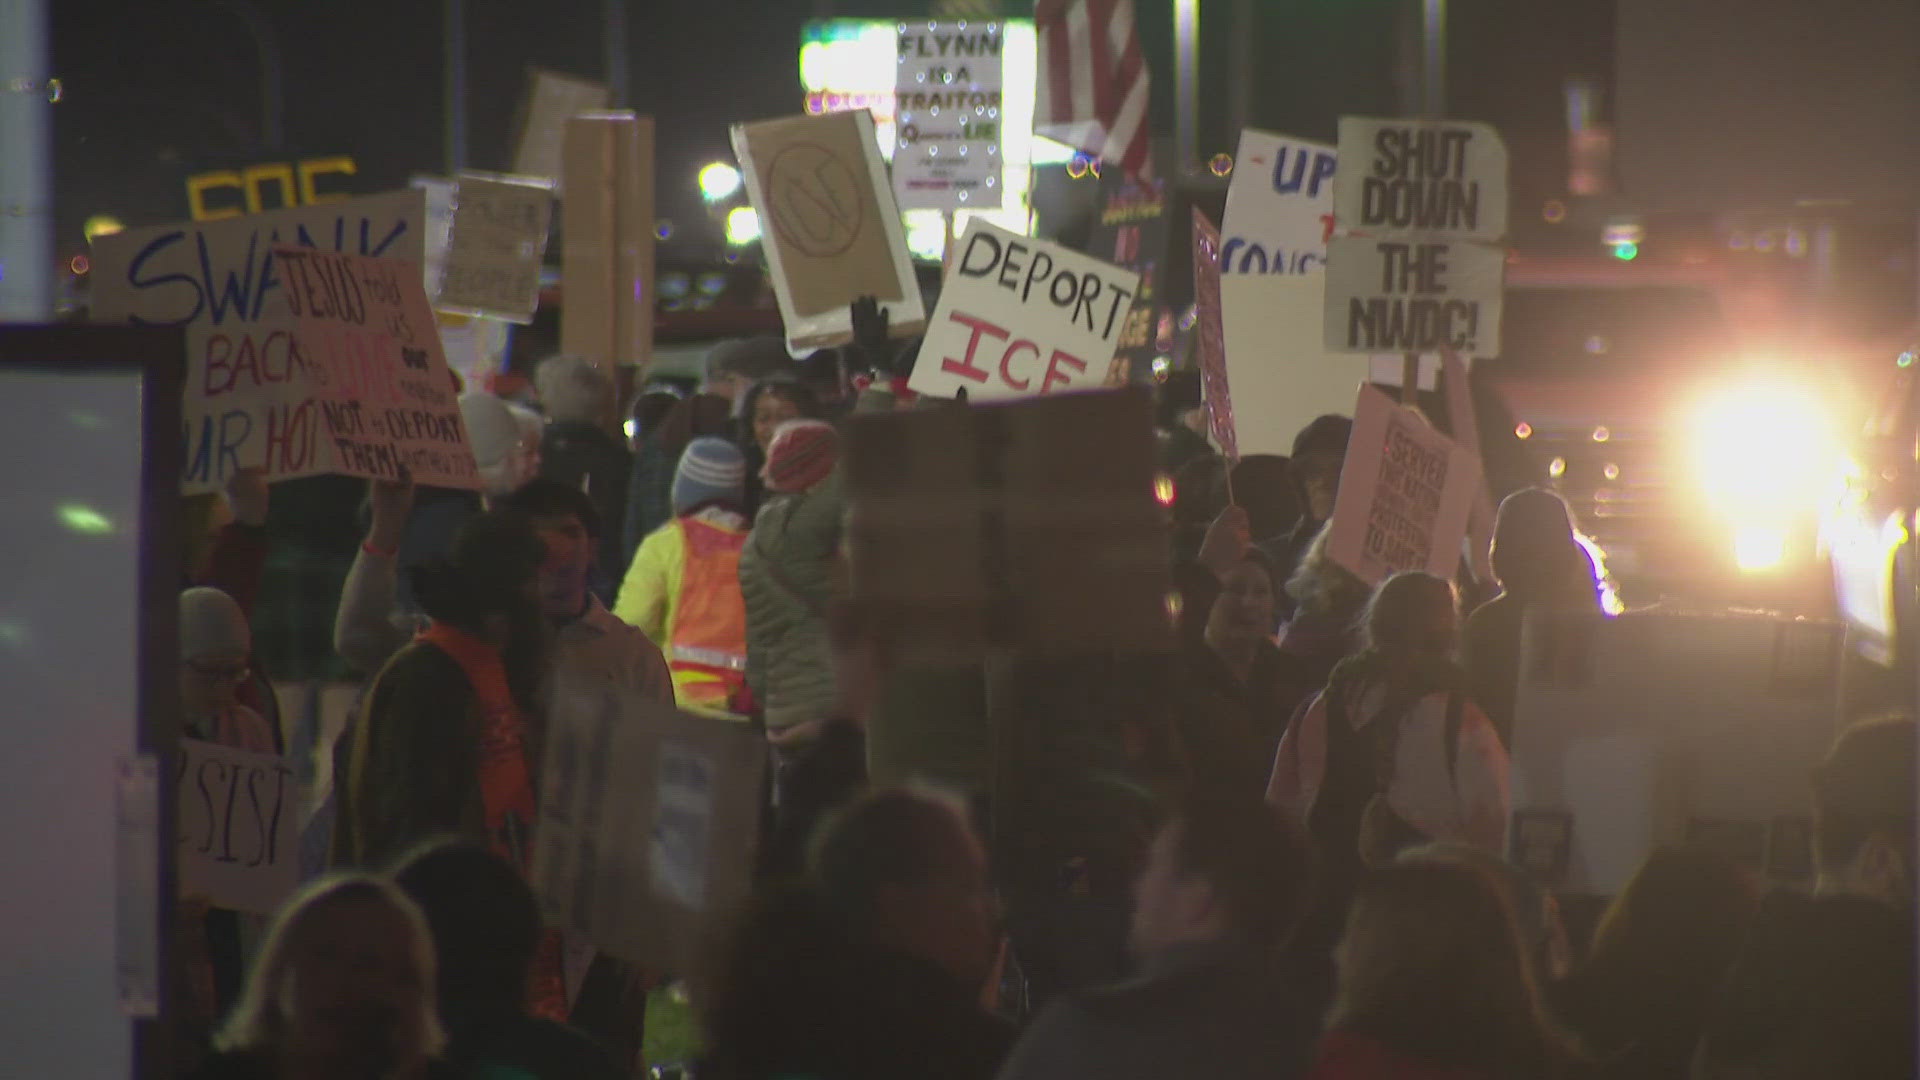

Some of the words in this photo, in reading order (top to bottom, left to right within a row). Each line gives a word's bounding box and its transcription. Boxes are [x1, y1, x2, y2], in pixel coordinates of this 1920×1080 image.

[899, 34, 1002, 57] FLYNN
[899, 91, 1001, 110] TRAITOR
[956, 66, 971, 83] A
[1373, 127, 1473, 182] SHUT
[1360, 177, 1479, 231] DOWN
[274, 250, 365, 327] JESUS
[958, 231, 1132, 342] DEPORT
[1376, 242, 1449, 295] THE
[1347, 297, 1479, 352] NWDC!
[322, 399, 365, 437] NOT
[385, 408, 462, 444] DEPORT
[177, 750, 293, 867] SIST
